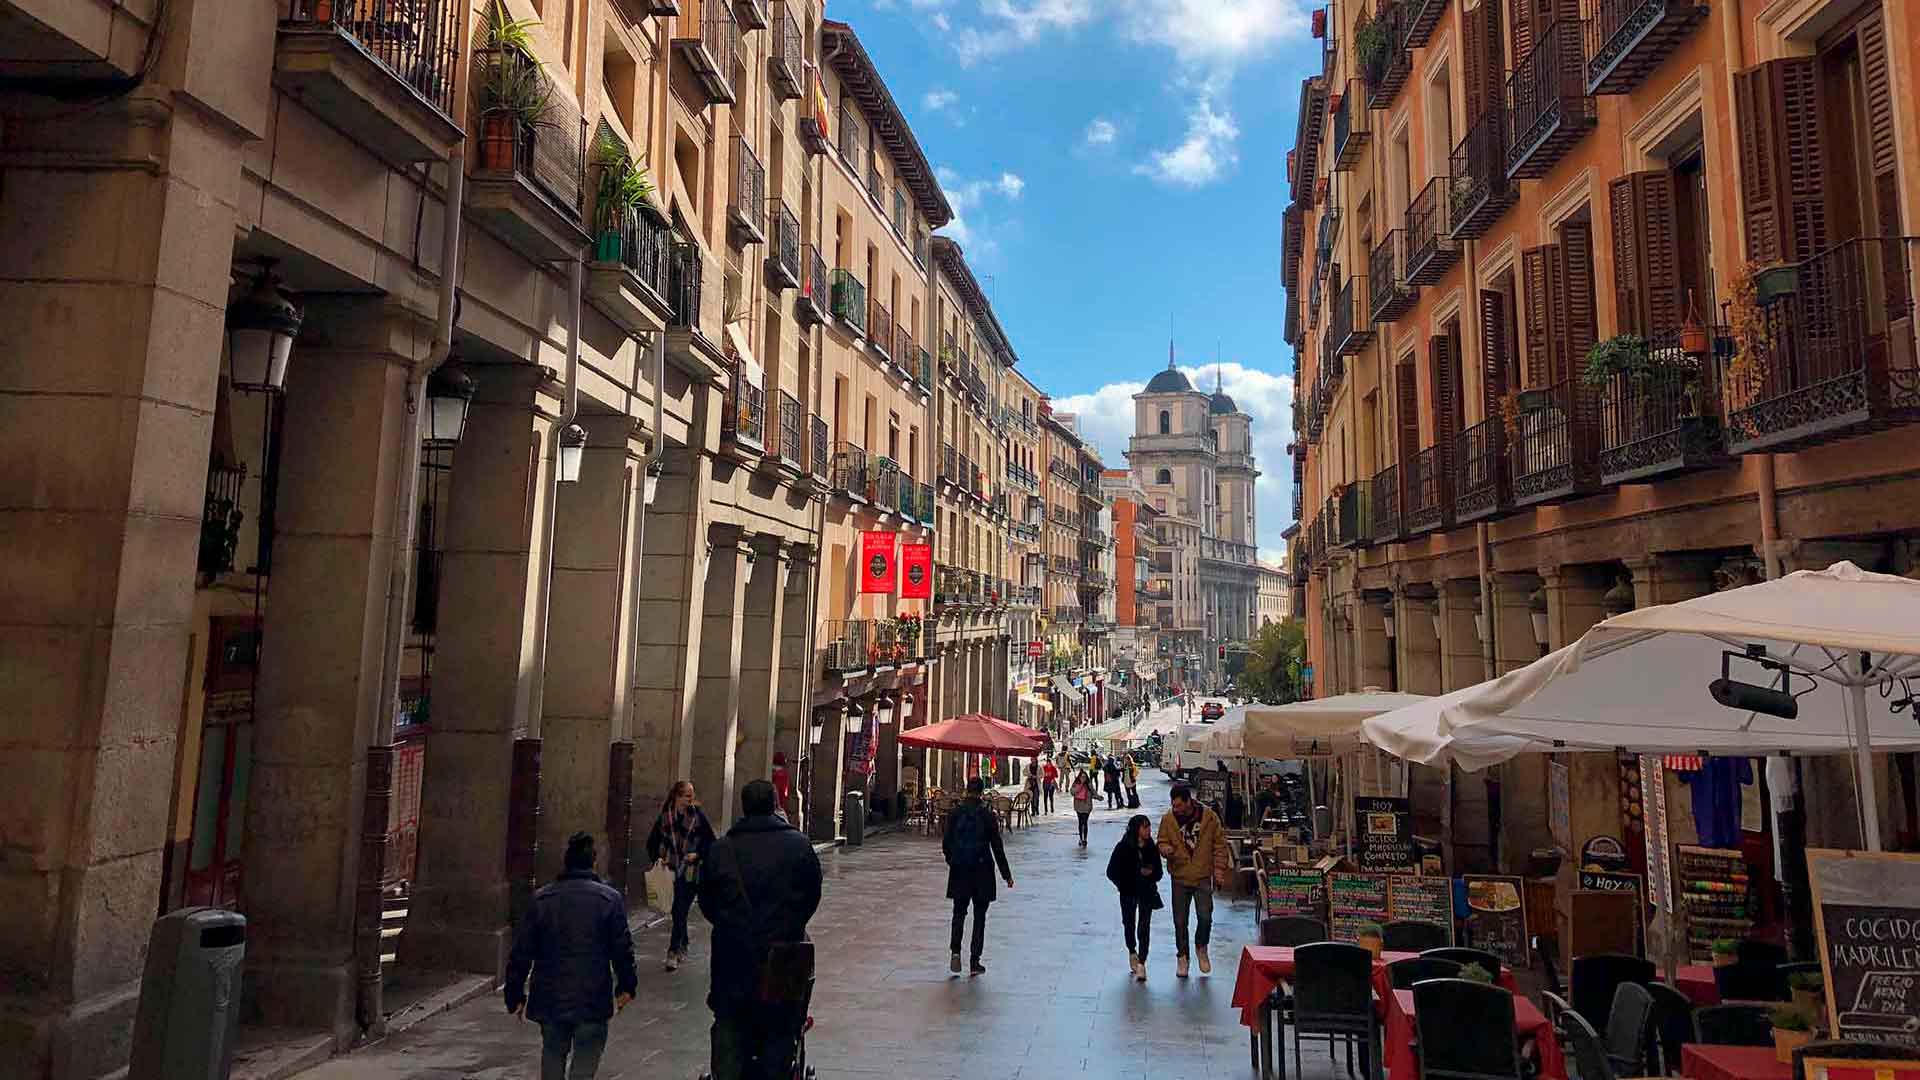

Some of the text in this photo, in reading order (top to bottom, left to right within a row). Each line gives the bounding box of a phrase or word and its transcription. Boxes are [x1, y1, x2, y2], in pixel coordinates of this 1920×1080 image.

[1596, 876, 1622, 890] HOY
[1846, 918, 1920, 941] COCIDO
[1871, 975, 1914, 989] PRECIO
